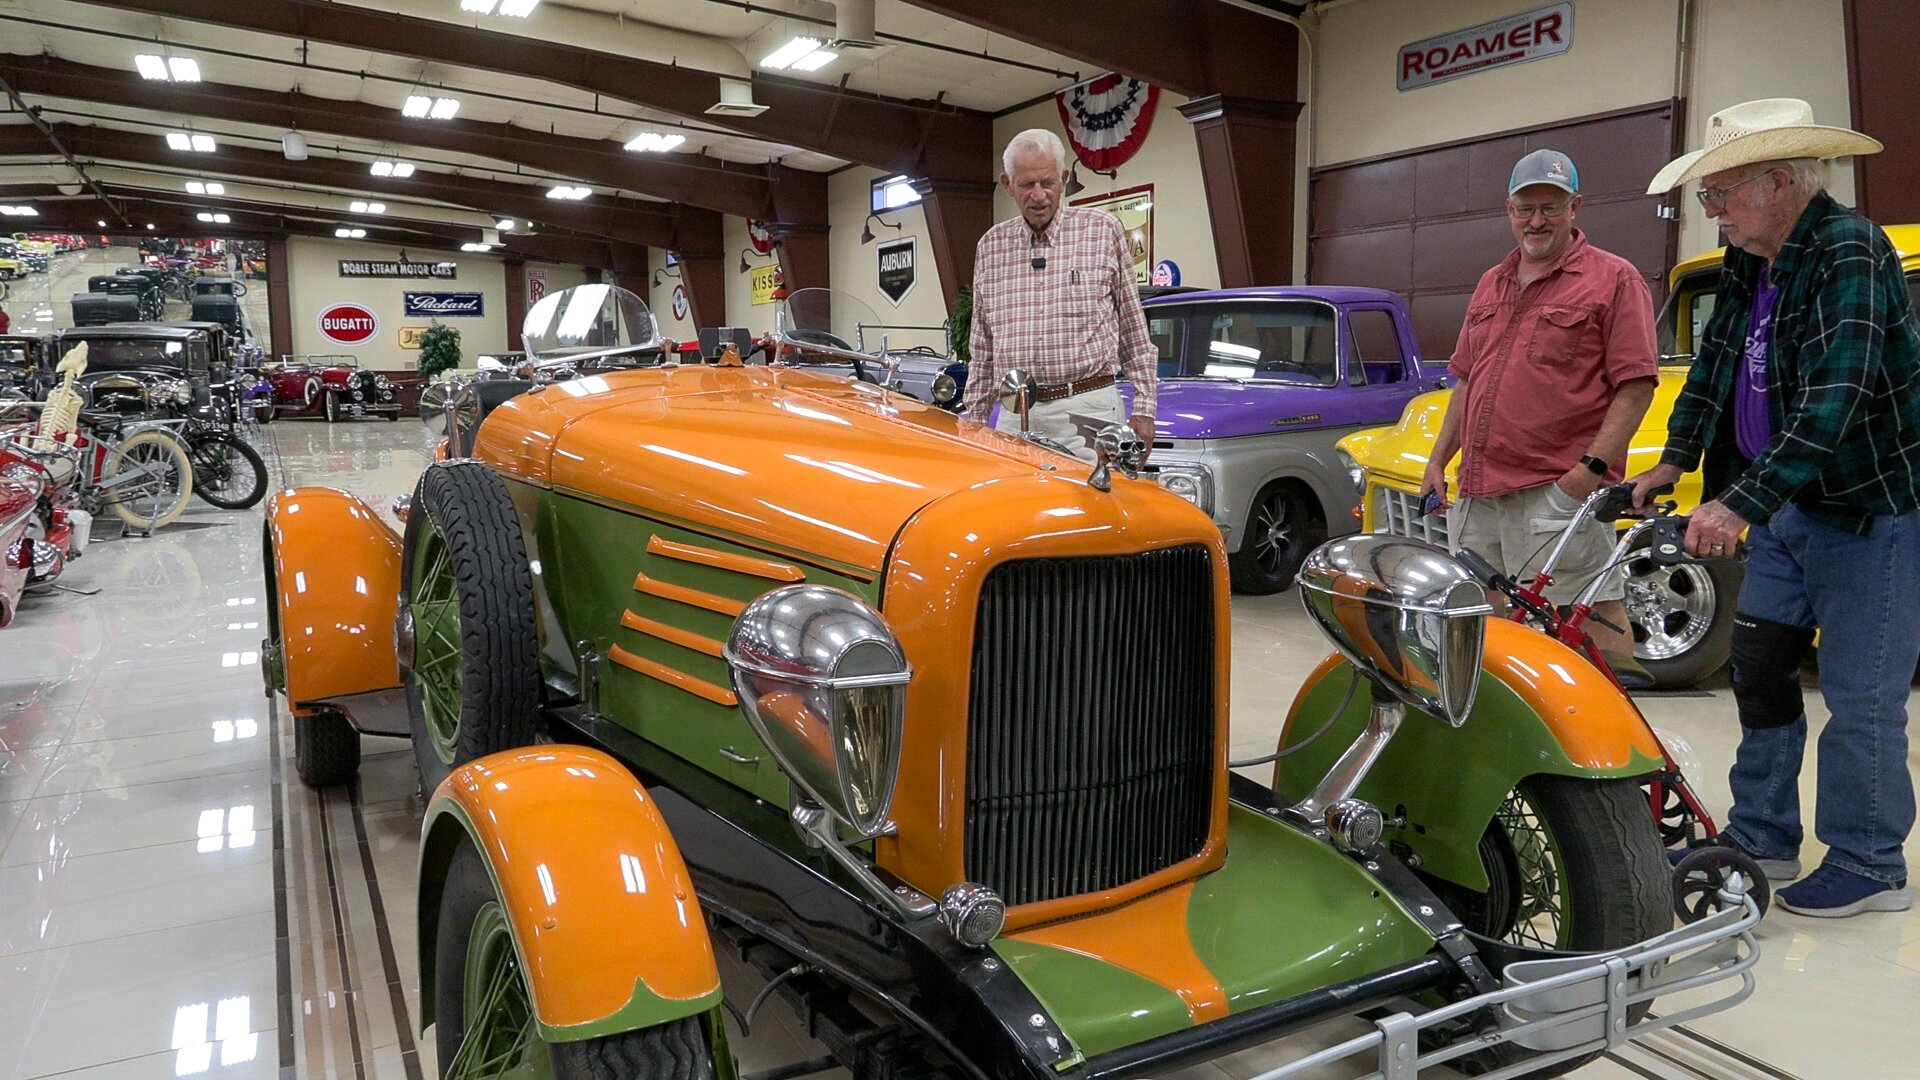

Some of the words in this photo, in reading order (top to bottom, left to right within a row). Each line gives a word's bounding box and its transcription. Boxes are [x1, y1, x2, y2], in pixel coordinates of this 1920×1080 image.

[1402, 14, 1562, 81] ROAMER
[342, 263, 370, 274] DOBLE
[371, 263, 399, 275] STEAM
[399, 263, 430, 275] MOTOR
[880, 250, 913, 272] AUBURN
[410, 295, 478, 312] Packard
[323, 318, 373, 330] BUGATTI
